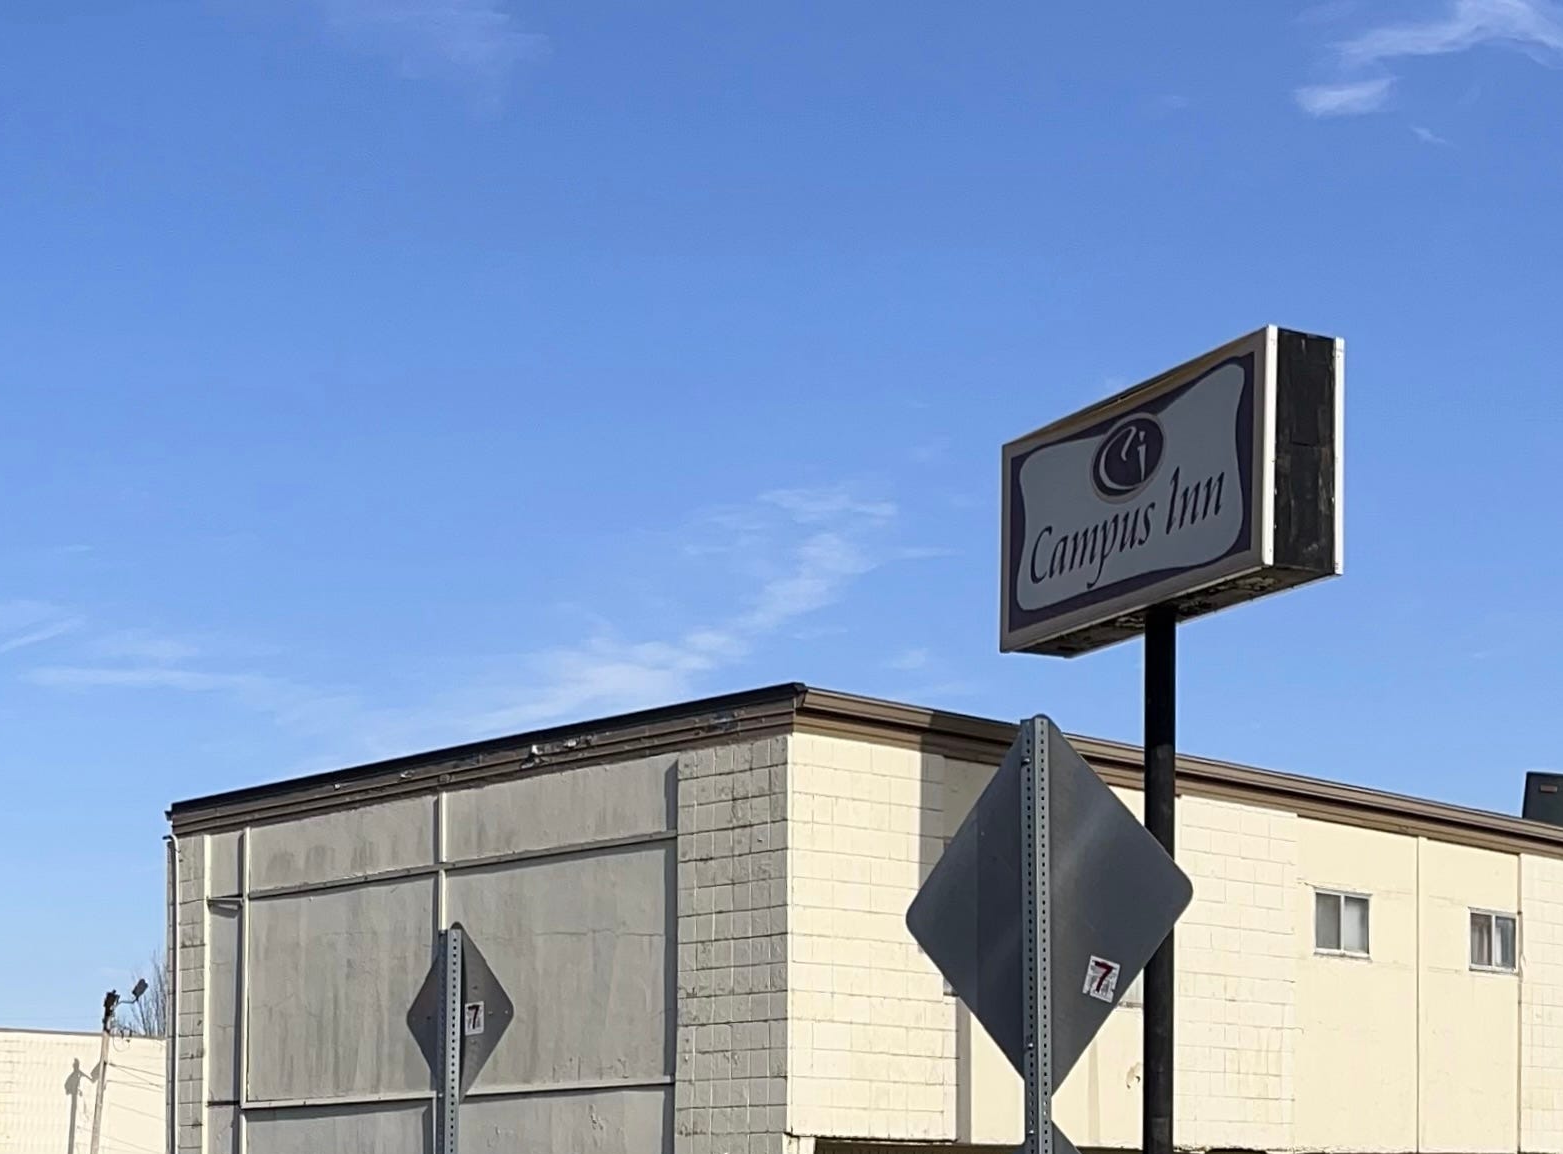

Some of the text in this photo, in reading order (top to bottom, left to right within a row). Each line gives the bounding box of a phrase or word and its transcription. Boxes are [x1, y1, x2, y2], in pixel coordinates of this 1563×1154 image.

[1030, 466, 1225, 589] Campus Inn
[1095, 961, 1114, 993] 7
[468, 1004, 480, 1030] 7
